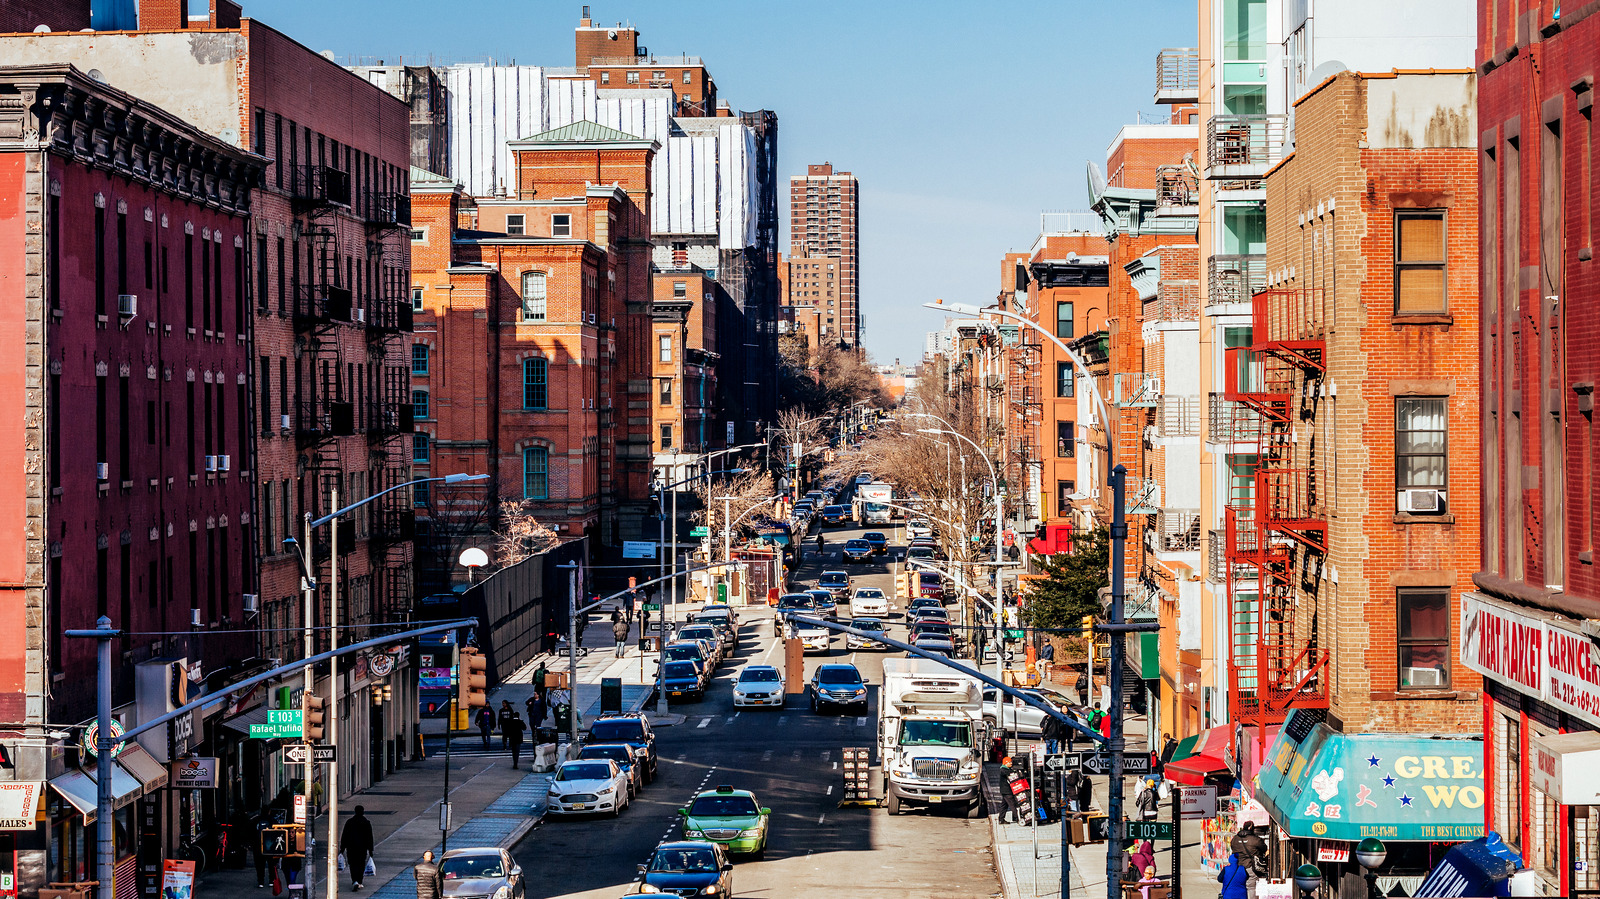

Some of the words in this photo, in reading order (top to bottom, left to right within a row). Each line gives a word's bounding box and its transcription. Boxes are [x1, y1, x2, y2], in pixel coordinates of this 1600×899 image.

[1478, 609, 1500, 674] MEAT
[1502, 618, 1542, 691] MARKET
[1548, 629, 1600, 688] CARNICER
[270, 712, 274, 722] E
[278, 712, 292, 722] 103
[252, 725, 276, 733] Rafael
[291, 750, 305, 758] ONE
[1089, 760, 1110, 768] ONE
[1123, 760, 1144, 768] WAY
[1394, 756, 1484, 779] GRE
[180, 768, 206, 776] boost
[1129, 824, 1135, 836] E
[1140, 824, 1156, 837] 103
[1161, 824, 1168, 833] St
[1421, 826, 1436, 837] THE
[1437, 826, 1453, 837] BEST
[1454, 826, 1484, 837] CHINESE
[4, 876, 10, 885] B
